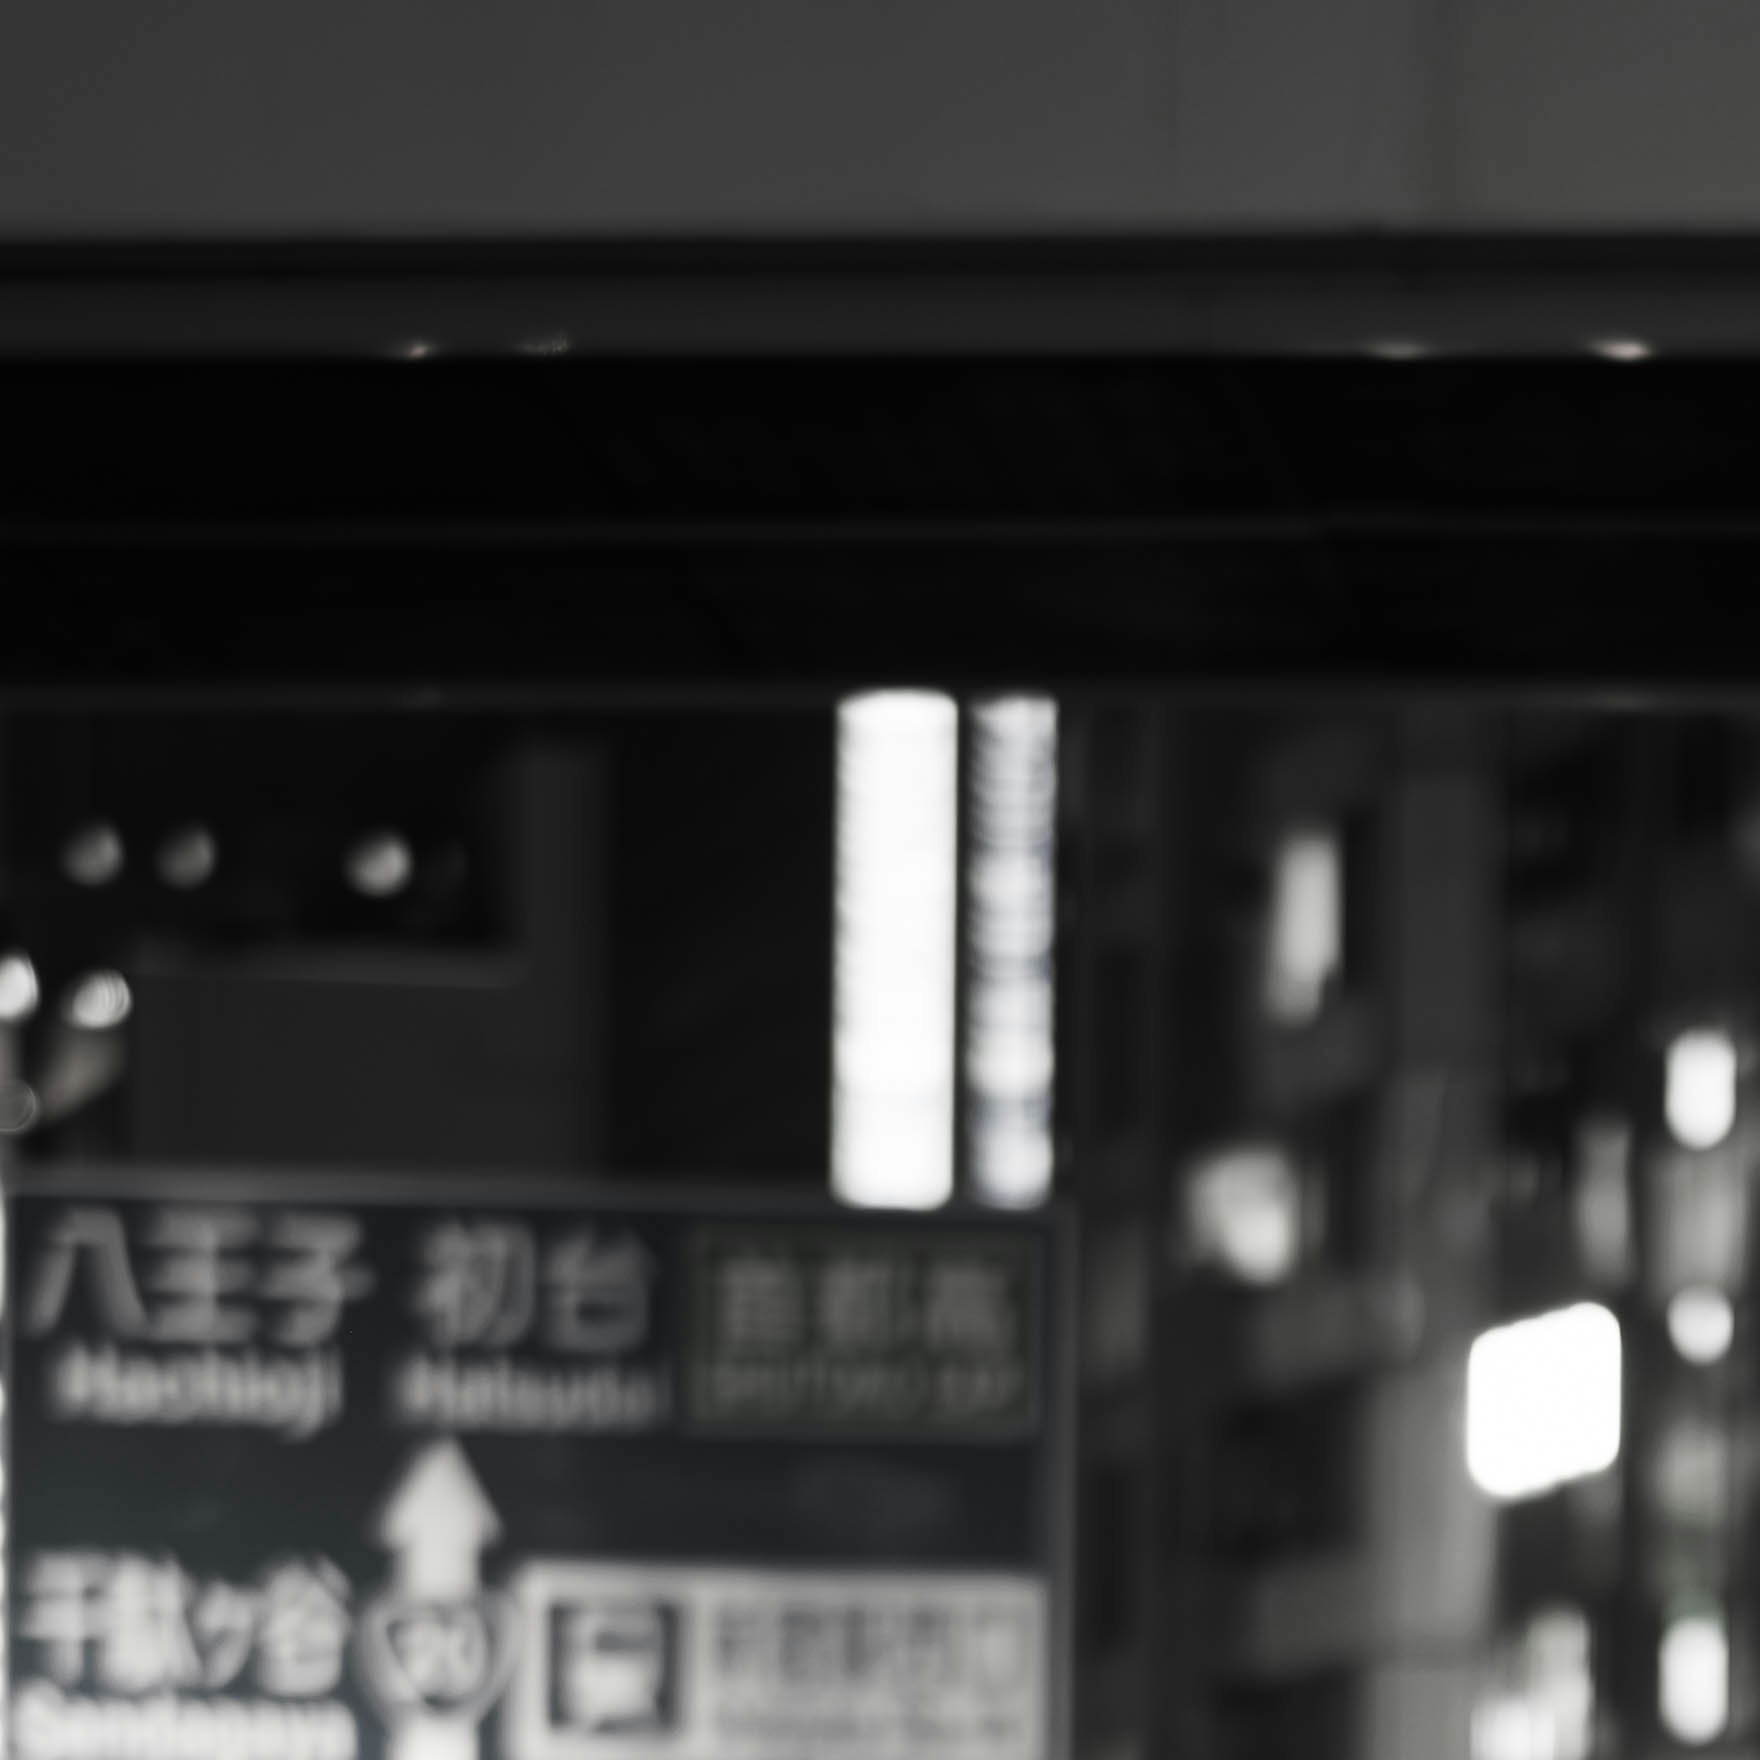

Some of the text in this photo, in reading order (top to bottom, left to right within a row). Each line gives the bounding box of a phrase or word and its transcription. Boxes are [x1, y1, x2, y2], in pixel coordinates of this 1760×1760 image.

[24, 1208, 375, 1346] 八王子
[416, 1217, 660, 1352] 初台
